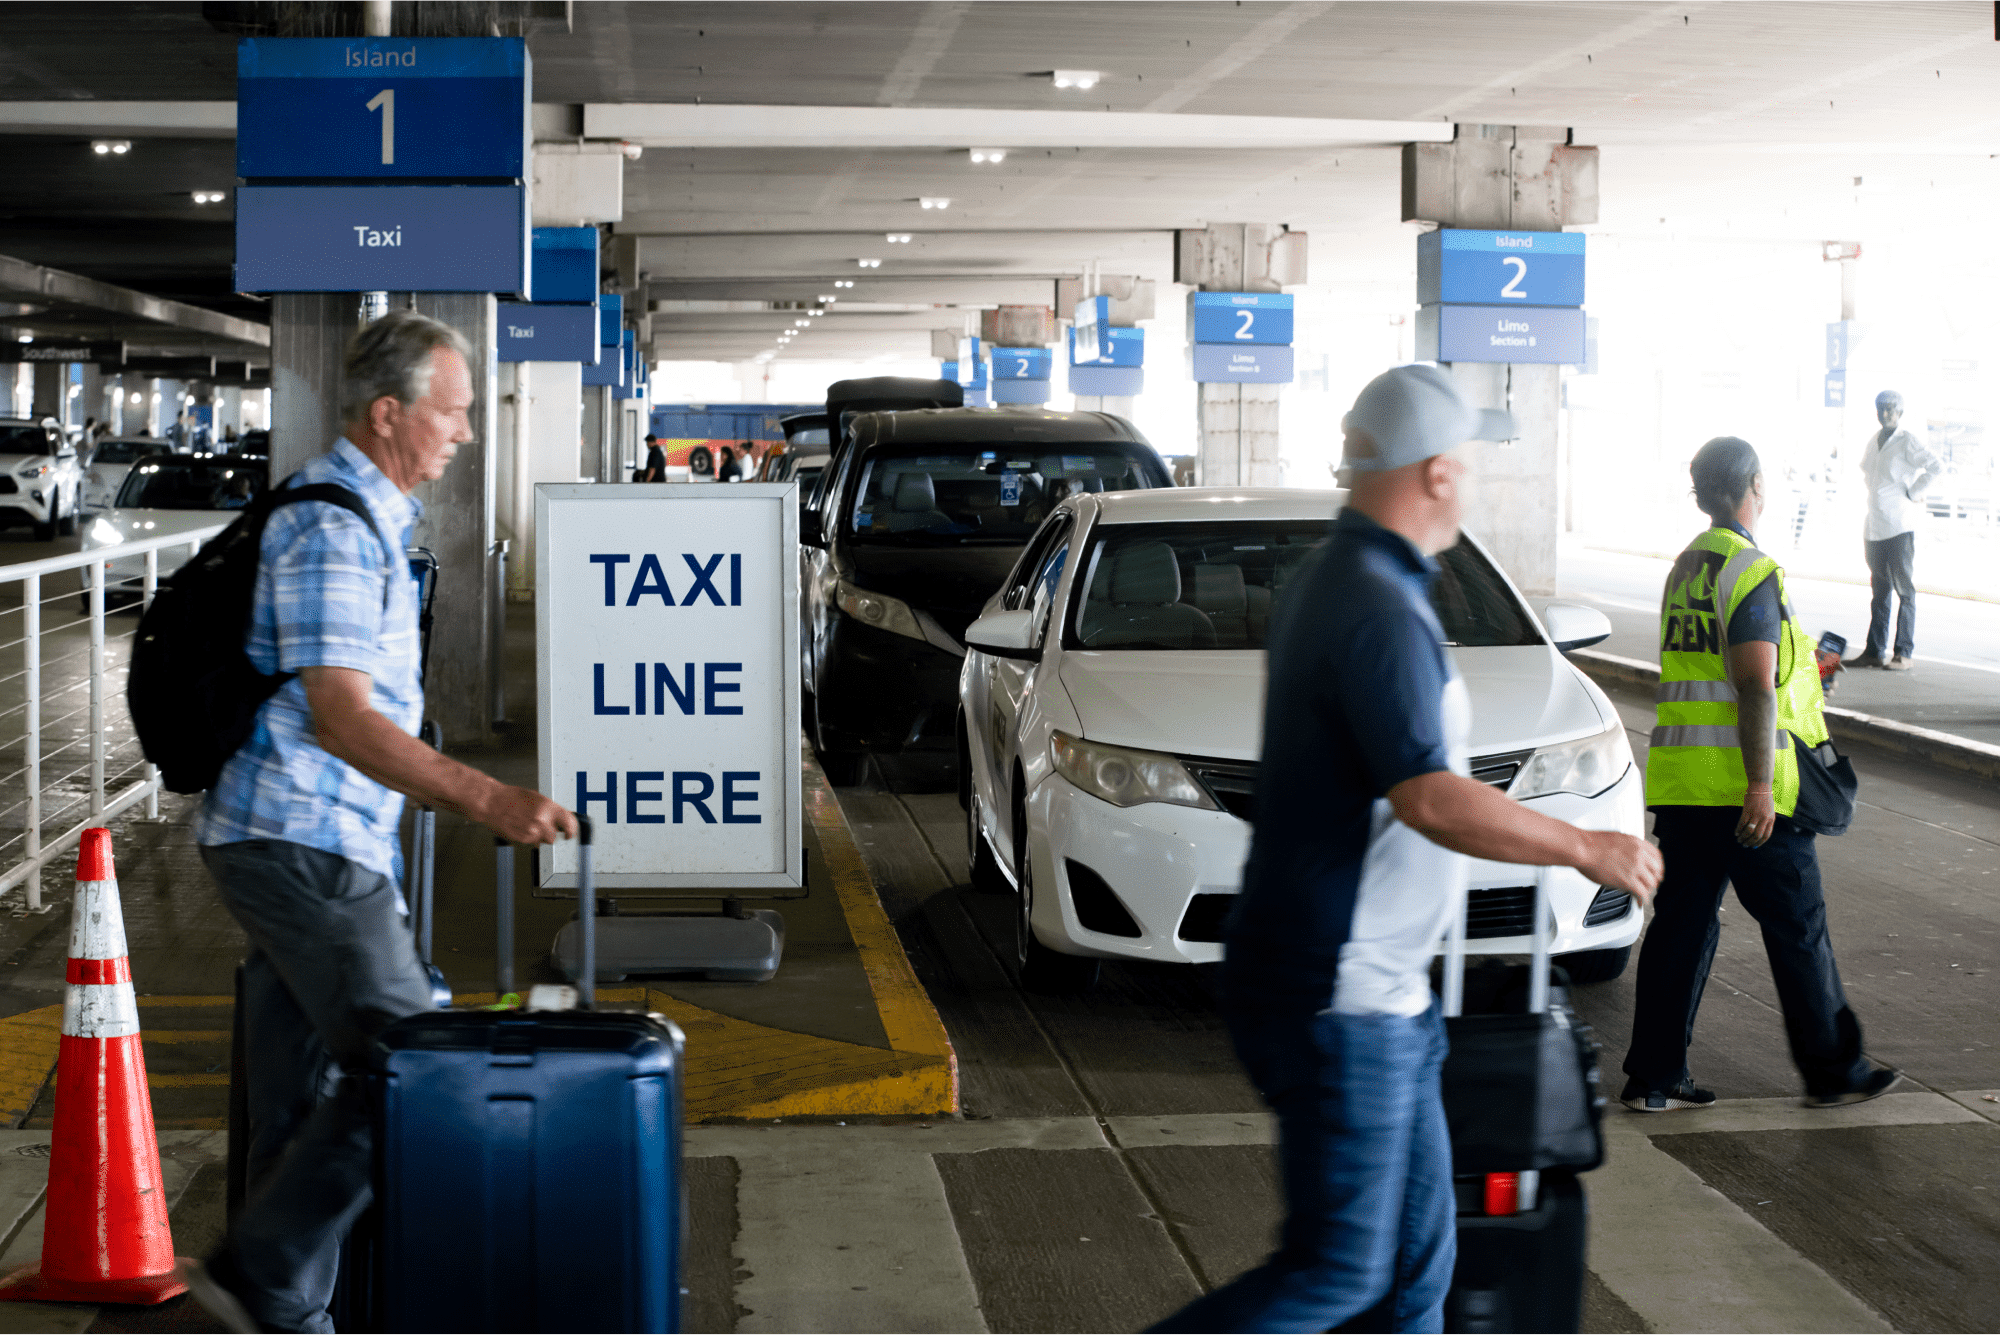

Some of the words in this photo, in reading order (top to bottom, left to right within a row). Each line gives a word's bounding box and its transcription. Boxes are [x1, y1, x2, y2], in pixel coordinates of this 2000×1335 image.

[346, 46, 416, 67] Island
[366, 89, 394, 164] 1
[354, 225, 401, 247] Taxi
[1496, 235, 1533, 248] Island
[1501, 256, 1527, 298] 2
[507, 325, 534, 338] Taxi
[1235, 310, 1254, 339] 2
[1498, 320, 1529, 333] Limo
[1490, 335, 1527, 347] Section
[1016, 358, 1029, 377] 2
[589, 553, 742, 607] TAXI
[1663, 614, 1720, 656] DEN
[593, 662, 744, 716] LINE
[576, 771, 762, 824] HERE
